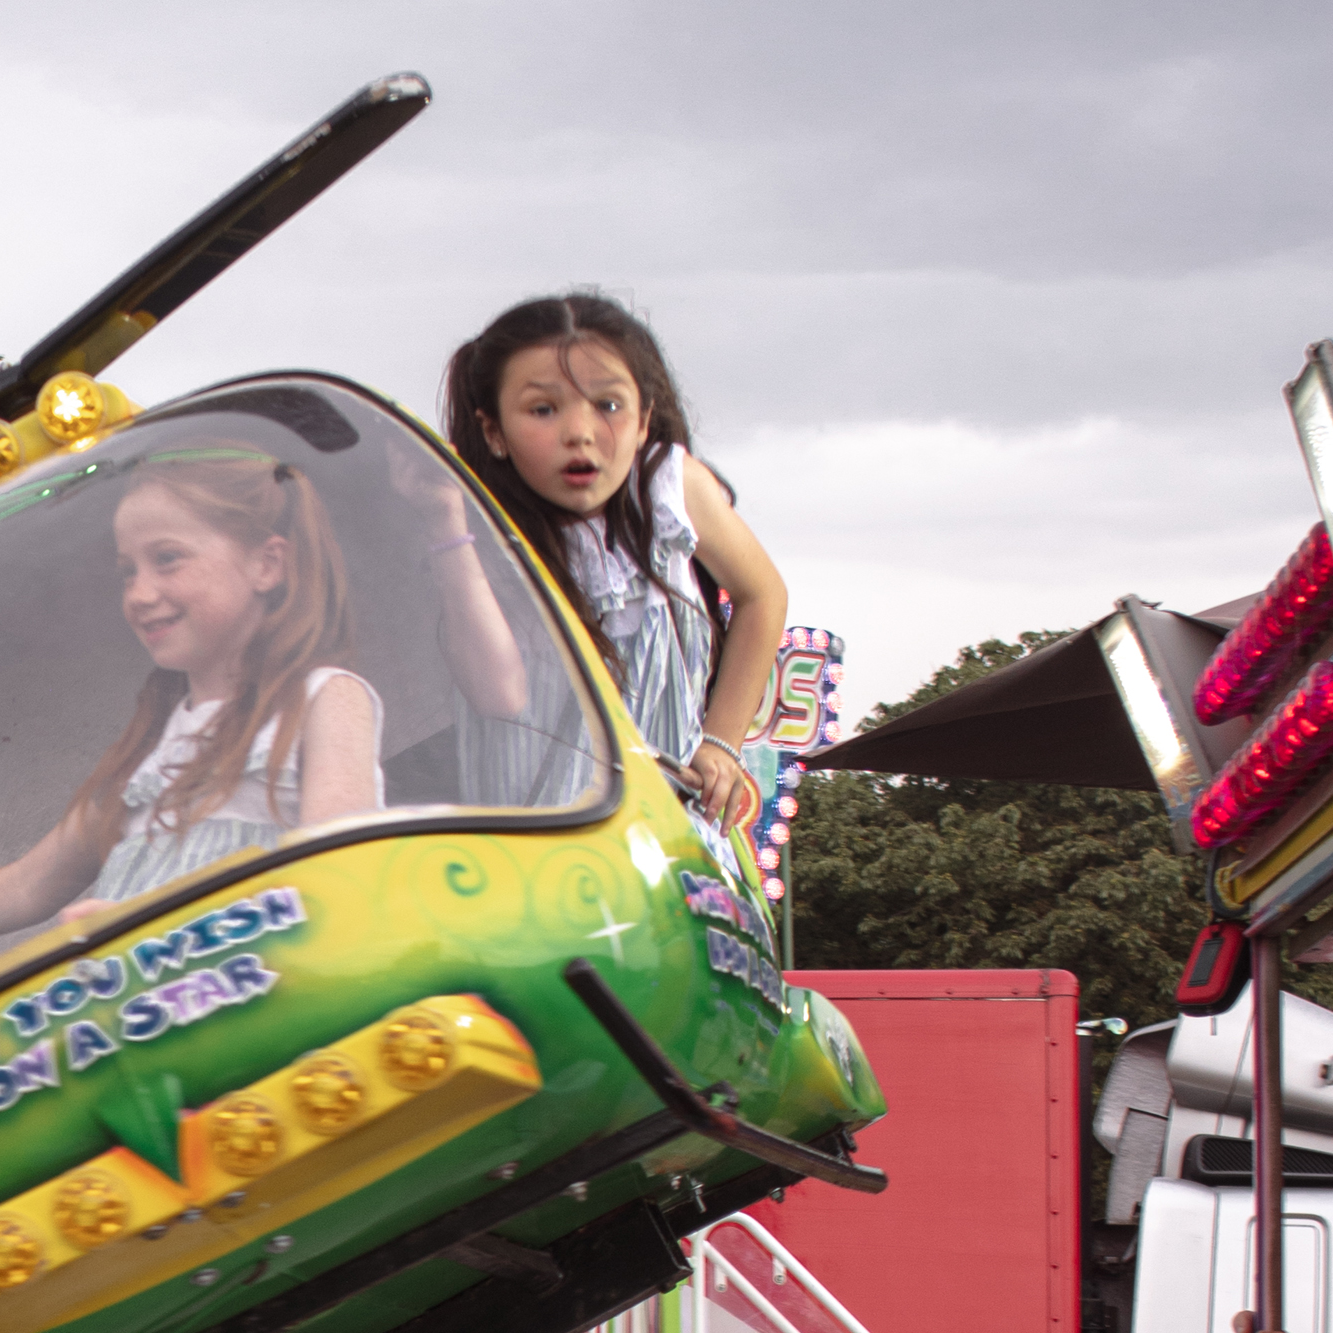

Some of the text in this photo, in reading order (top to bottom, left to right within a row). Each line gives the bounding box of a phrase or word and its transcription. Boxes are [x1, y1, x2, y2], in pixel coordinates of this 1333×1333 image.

[3, 955, 126, 1037] YOU
[129, 886, 308, 983] WISH
[64, 1019, 122, 1072] A
[120, 952, 280, 1042] STAR
